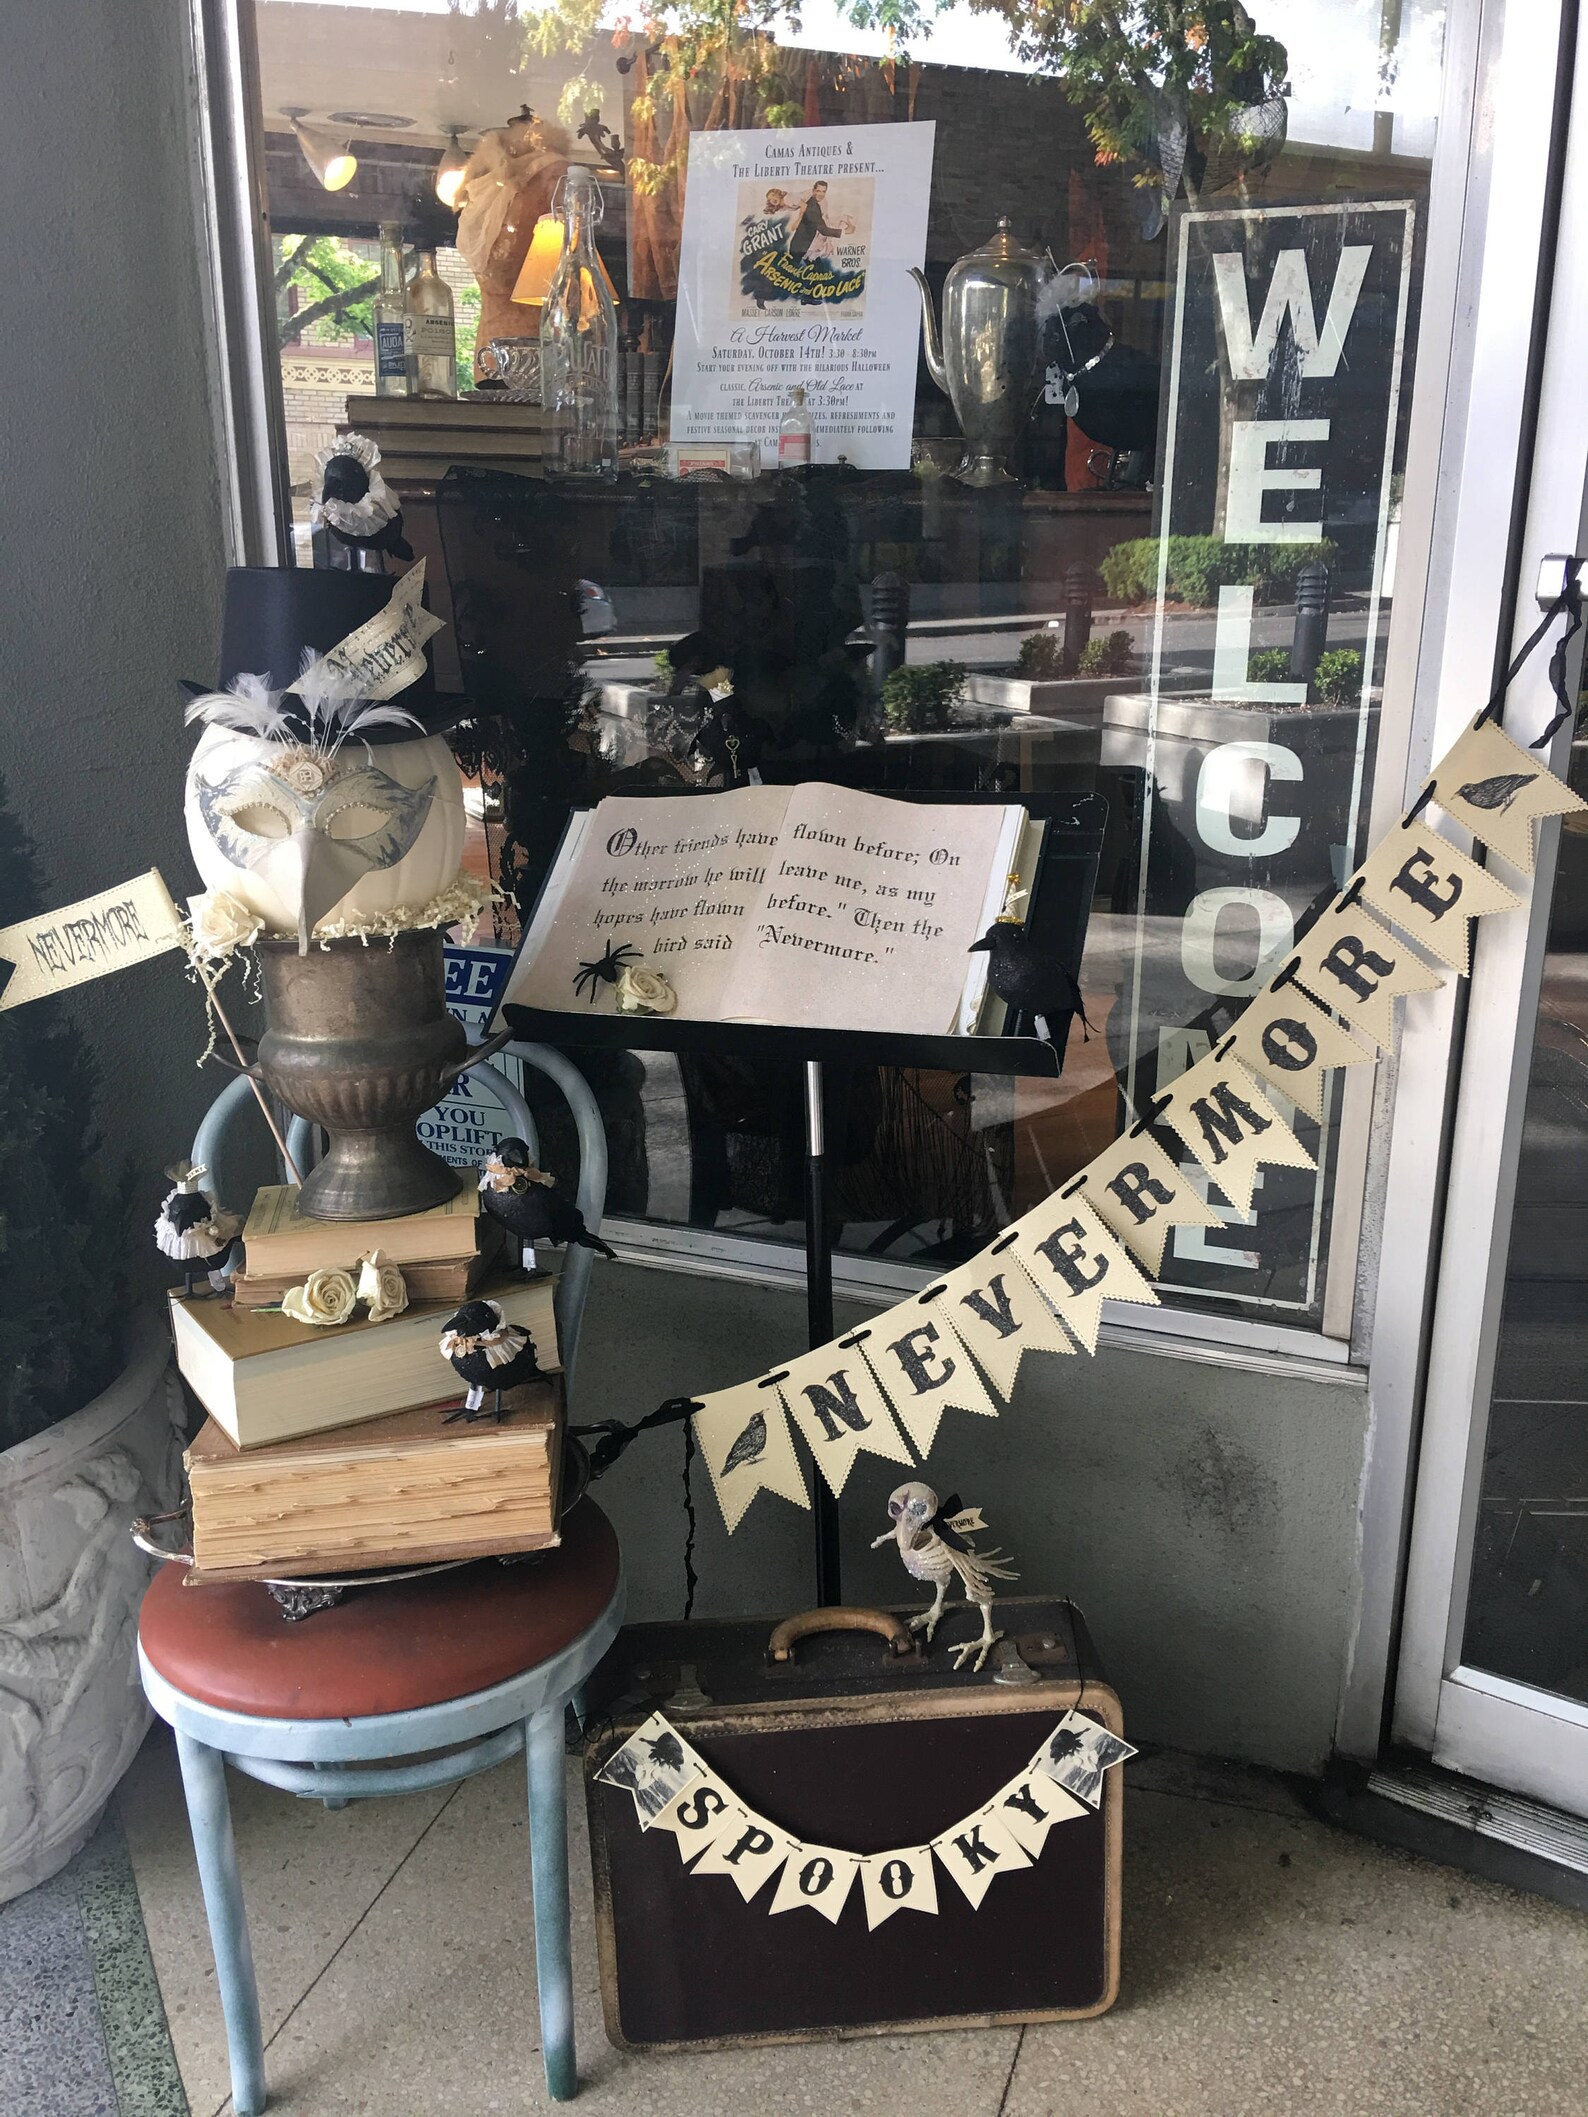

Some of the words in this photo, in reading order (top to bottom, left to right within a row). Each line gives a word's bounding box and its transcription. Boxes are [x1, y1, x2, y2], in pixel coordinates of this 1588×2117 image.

[846, 141, 853, 155] &
[742, 223, 785, 256] GRANT
[747, 220, 769, 237] CARY
[836, 244, 867, 256] WARNER
[812, 283, 836, 299] OLD
[730, 327, 746, 343] A
[746, 325, 806, 345] Harvest
[807, 324, 864, 344] Market
[748, 377, 783, 392] Arsenic
[806, 379, 830, 392] Old
[829, 376, 855, 395] Lace
[606, 828, 667, 859] Other
[673, 832, 728, 856] friends
[735, 827, 778, 850] have
[793, 823, 846, 848] flown
[854, 836, 919, 866] before;
[929, 848, 961, 867] On
[602, 876, 628, 895] the
[634, 876, 698, 891] morrow
[703, 869, 724, 889] he
[729, 868, 766, 885] will
[778, 860, 829, 883] leave
[835, 875, 868, 895] me,
[876, 885, 899, 898] as
[907, 888, 936, 908] my
[593, 909, 644, 928] hopes
[650, 907, 688, 926] have
[694, 901, 744, 917] flown
[766, 893, 847, 920] before."
[854, 908, 906, 935] Then
[913, 917, 944, 940] the
[26, 899, 150, 978] NEVERMORE
[653, 936, 688, 955] bird
[694, 935, 732, 952] said
[756, 925, 895, 964] "Nevermore."
[443, 957, 497, 999] EE
[434, 1106, 486, 1127] YOU
[416, 1121, 503, 1147] OPLIFT
[426, 1140, 457, 1153] THIS
[800, 846, 1464, 1443] NEVERMORE
[471, 1159, 483, 1167] OF
[676, 1782, 1051, 1901] SPOOKY
